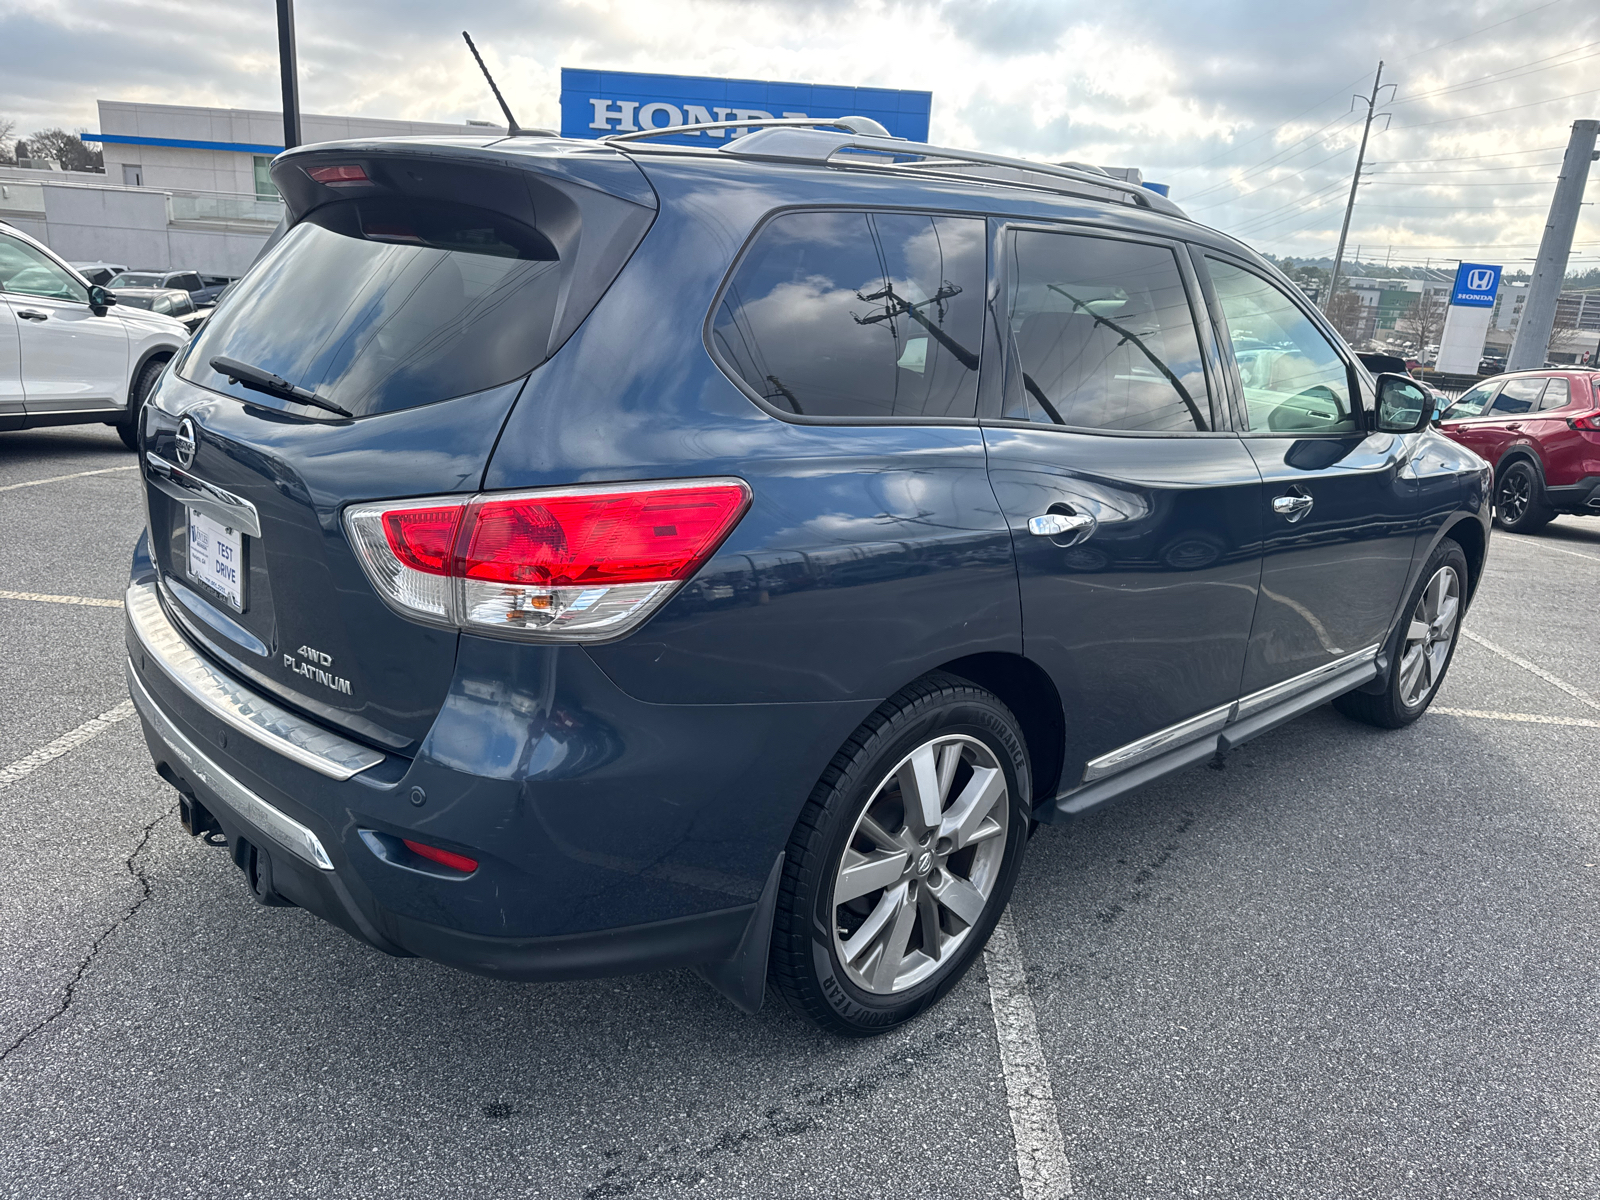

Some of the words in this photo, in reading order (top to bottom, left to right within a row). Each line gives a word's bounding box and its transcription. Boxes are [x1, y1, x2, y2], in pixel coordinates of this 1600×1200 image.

[589, 98, 816, 138] HOND
[1457, 293, 1493, 301] HONDA
[217, 541, 233, 562] TEST
[215, 560, 236, 584] DRIVE
[297, 645, 332, 667] 4WD
[283, 653, 353, 695] PLATINUM
